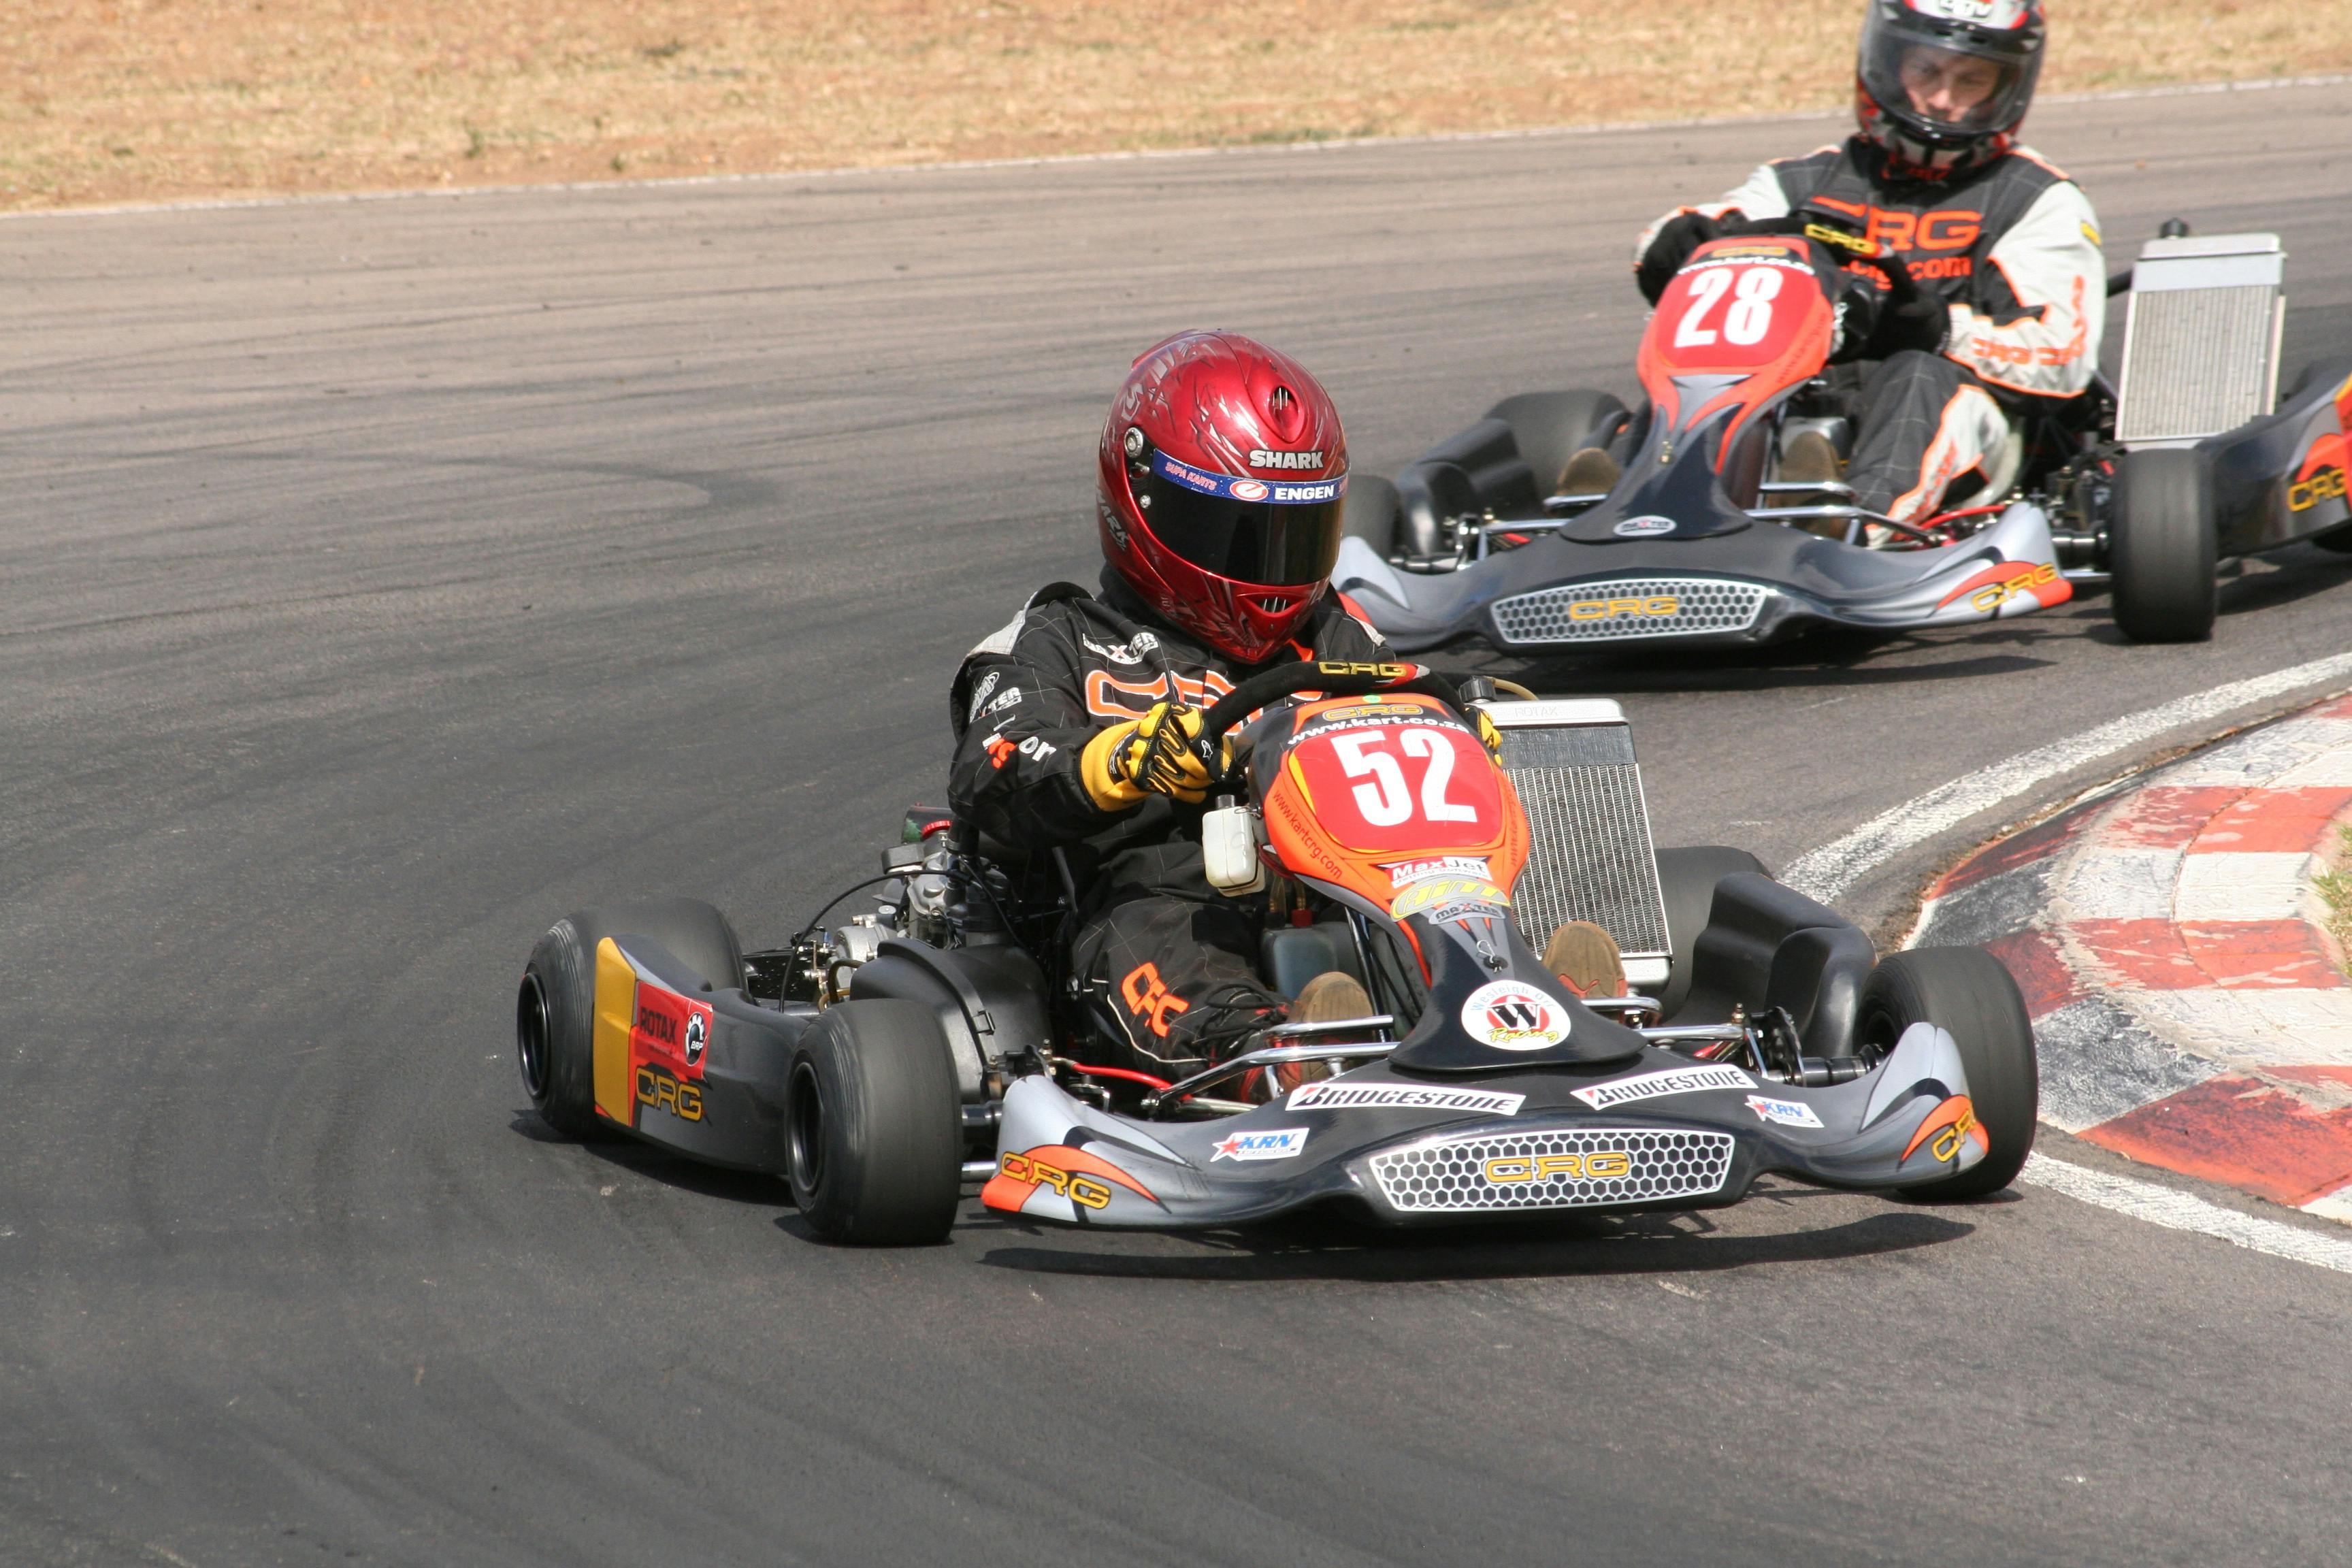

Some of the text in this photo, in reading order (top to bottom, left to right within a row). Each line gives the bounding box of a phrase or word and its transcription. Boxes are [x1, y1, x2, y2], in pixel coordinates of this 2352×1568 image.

[1809, 196, 1982, 251] RG
[1673, 267, 1784, 348] 28
[1249, 450, 1324, 469] SHARK
[1165, 461, 1217, 490] SUPA KARTS
[1275, 484, 1335, 500] ENGEN
[1971, 562, 2057, 612] CRG
[1569, 596, 1678, 621] CRG
[1318, 662, 1407, 678] CRG
[1325, 704, 1422, 720] CRG
[1514, 706, 1558, 717] ROTAX
[1288, 716, 1470, 745] www.kart.co.za
[1330, 728, 1478, 826] 52
[1273, 789, 1342, 879] www.kartcrg.com
[1470, 985, 1529, 1011] Wesleigh
[640, 1006, 679, 1046] ROTAX
[1486, 1026, 1559, 1043] Racing
[690, 1041, 704, 1051] BRP
[635, 1067, 704, 1122] CRG
[1291, 1087, 1515, 1112] BRIDGESTONE
[1586, 1068, 1747, 1108] BRIDGESTONE
[1237, 1132, 1299, 1149] KRN
[1931, 1108, 1977, 1162] CR
[1000, 1151, 1111, 1209] CRG
[1484, 1152, 1631, 1183] CRG
